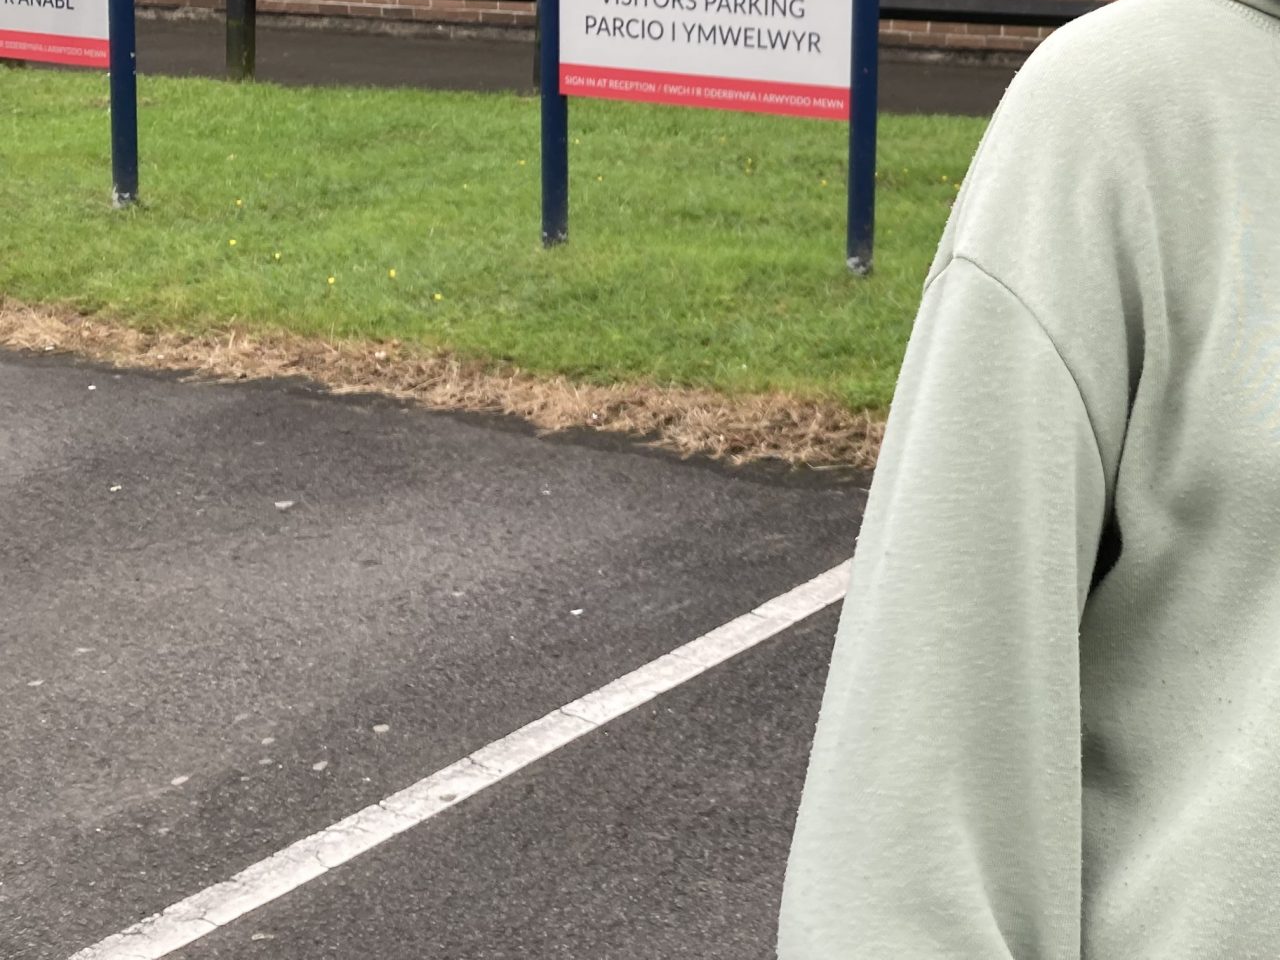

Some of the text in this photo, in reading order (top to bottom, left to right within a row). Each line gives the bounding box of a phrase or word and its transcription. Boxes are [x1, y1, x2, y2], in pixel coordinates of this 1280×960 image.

[585, 14, 821, 53] PARCIO I YMWELWYR
[564, 74, 585, 87] SIGN
[586, 76, 596, 88] IN
[597, 77, 608, 89] AT
[608, 79, 656, 93] RECEPTION
[763, 92, 811, 106] ARWYDDO
[812, 96, 845, 110] MEWN
